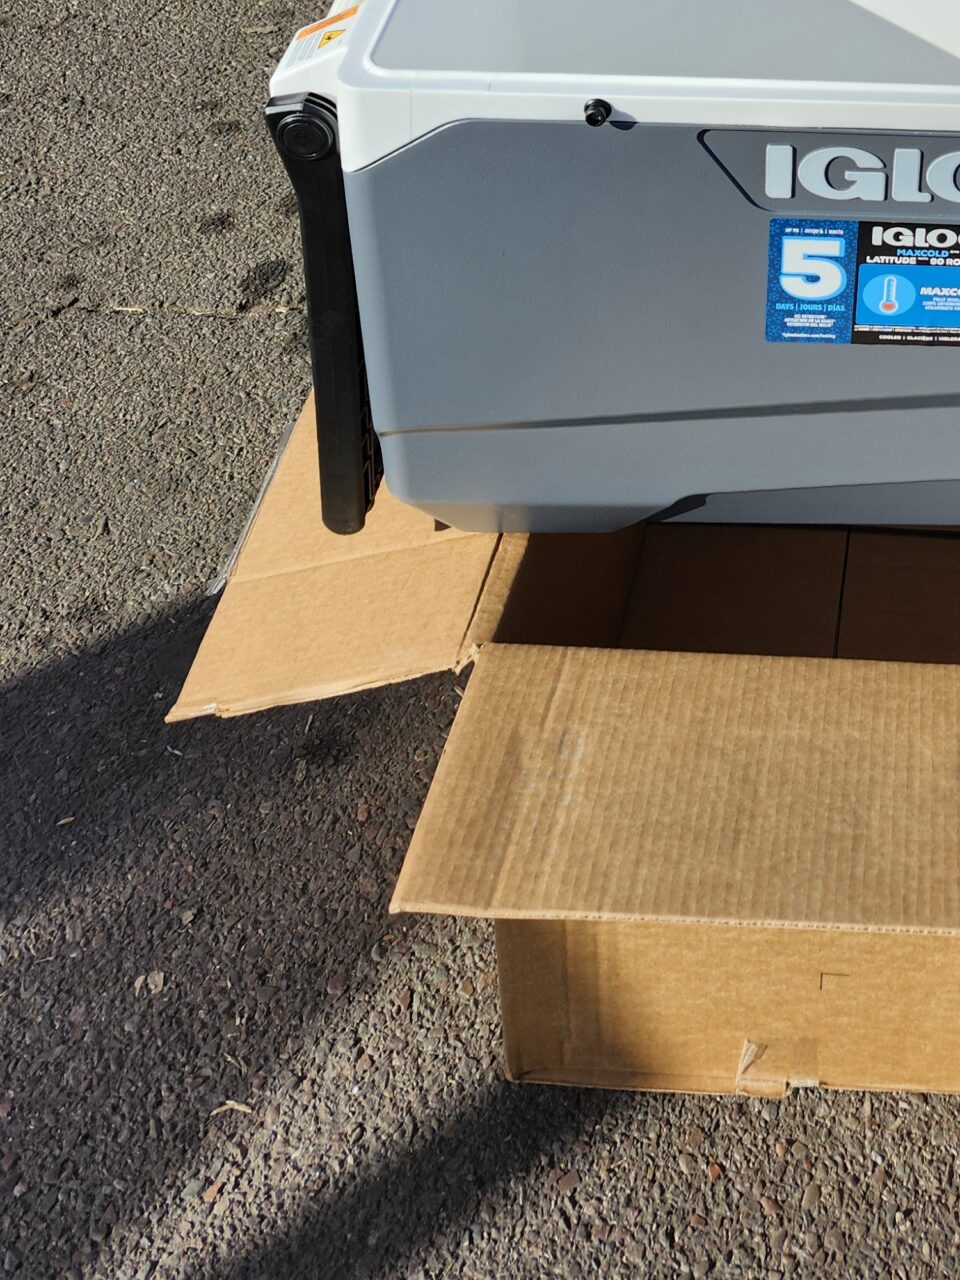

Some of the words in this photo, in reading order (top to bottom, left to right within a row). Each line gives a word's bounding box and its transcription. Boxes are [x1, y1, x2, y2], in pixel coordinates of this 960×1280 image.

[896, 248, 949, 258] MAXCOLD
[866, 255, 917, 265] LATITUDE
[779, 236, 847, 301] 5
